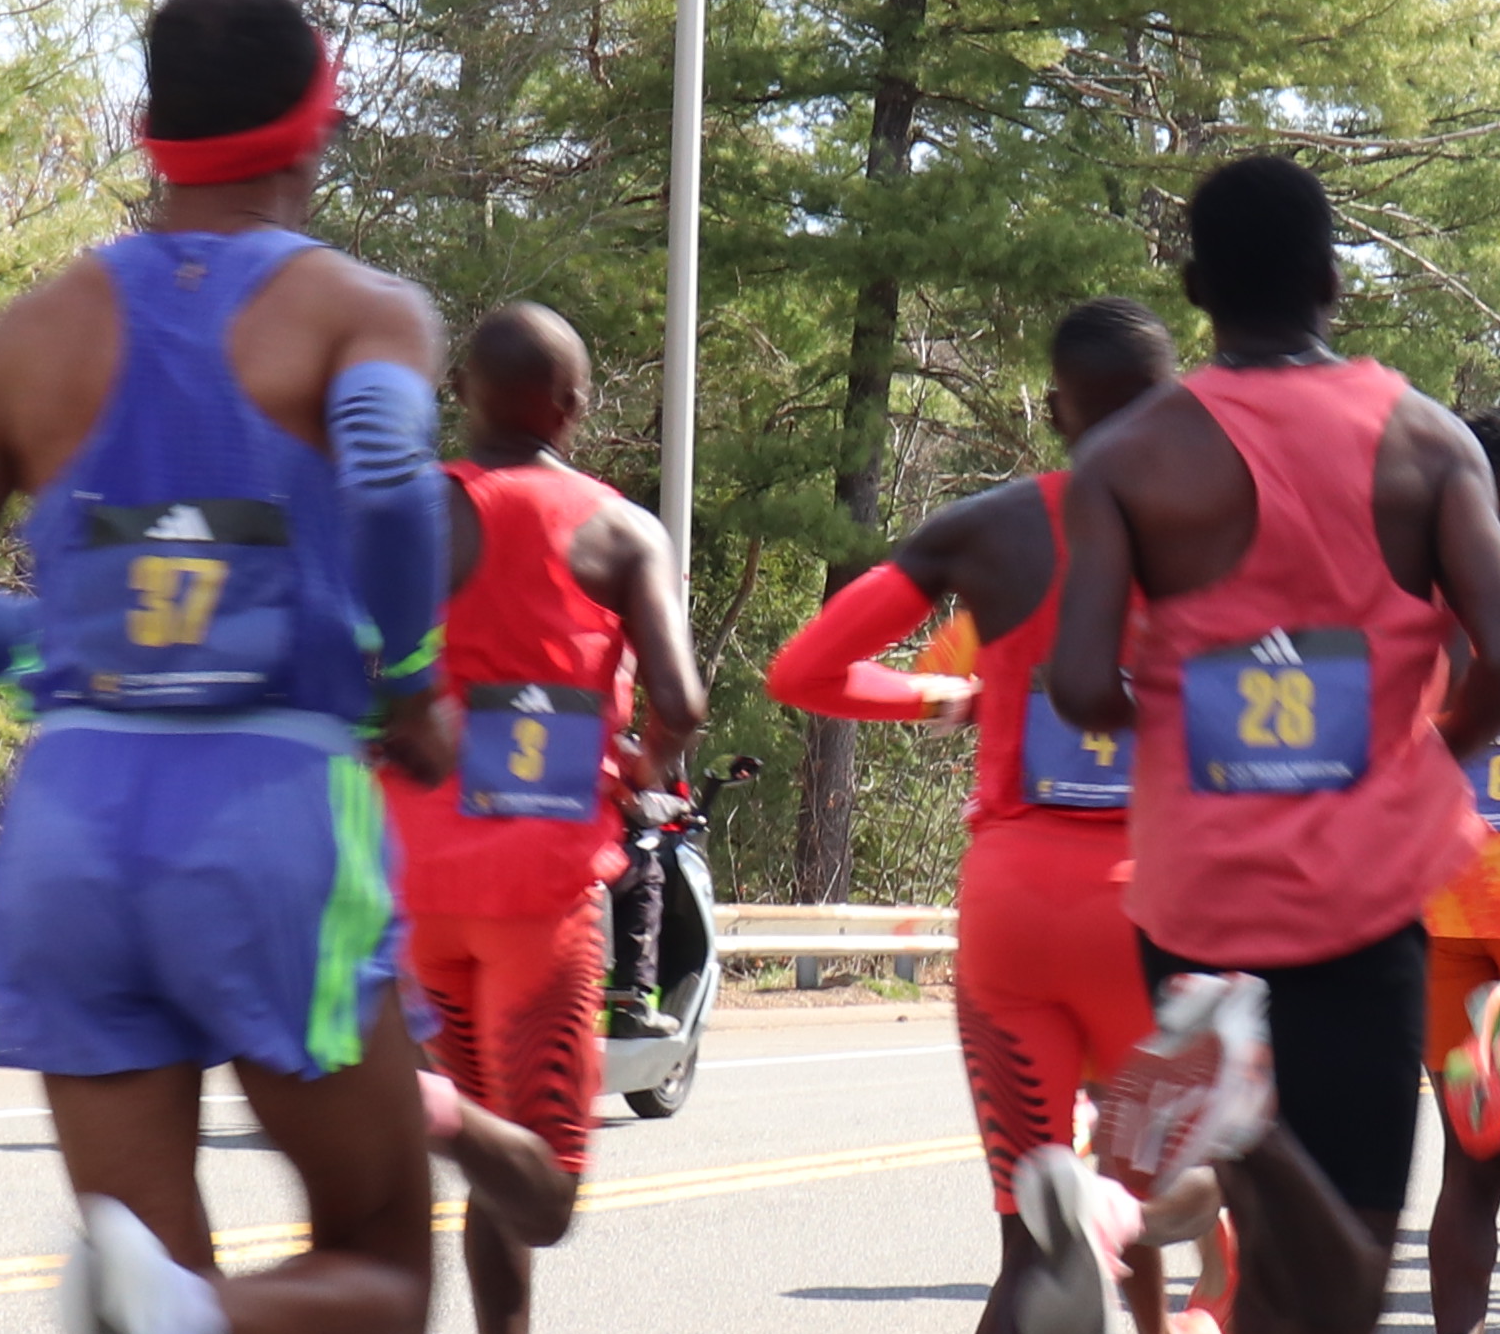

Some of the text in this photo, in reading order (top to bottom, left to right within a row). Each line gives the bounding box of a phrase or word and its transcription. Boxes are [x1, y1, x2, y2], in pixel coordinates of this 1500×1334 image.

[126, 555, 230, 647] 37
[1238, 667, 1316, 749] 28
[508, 717, 548, 782] 3
